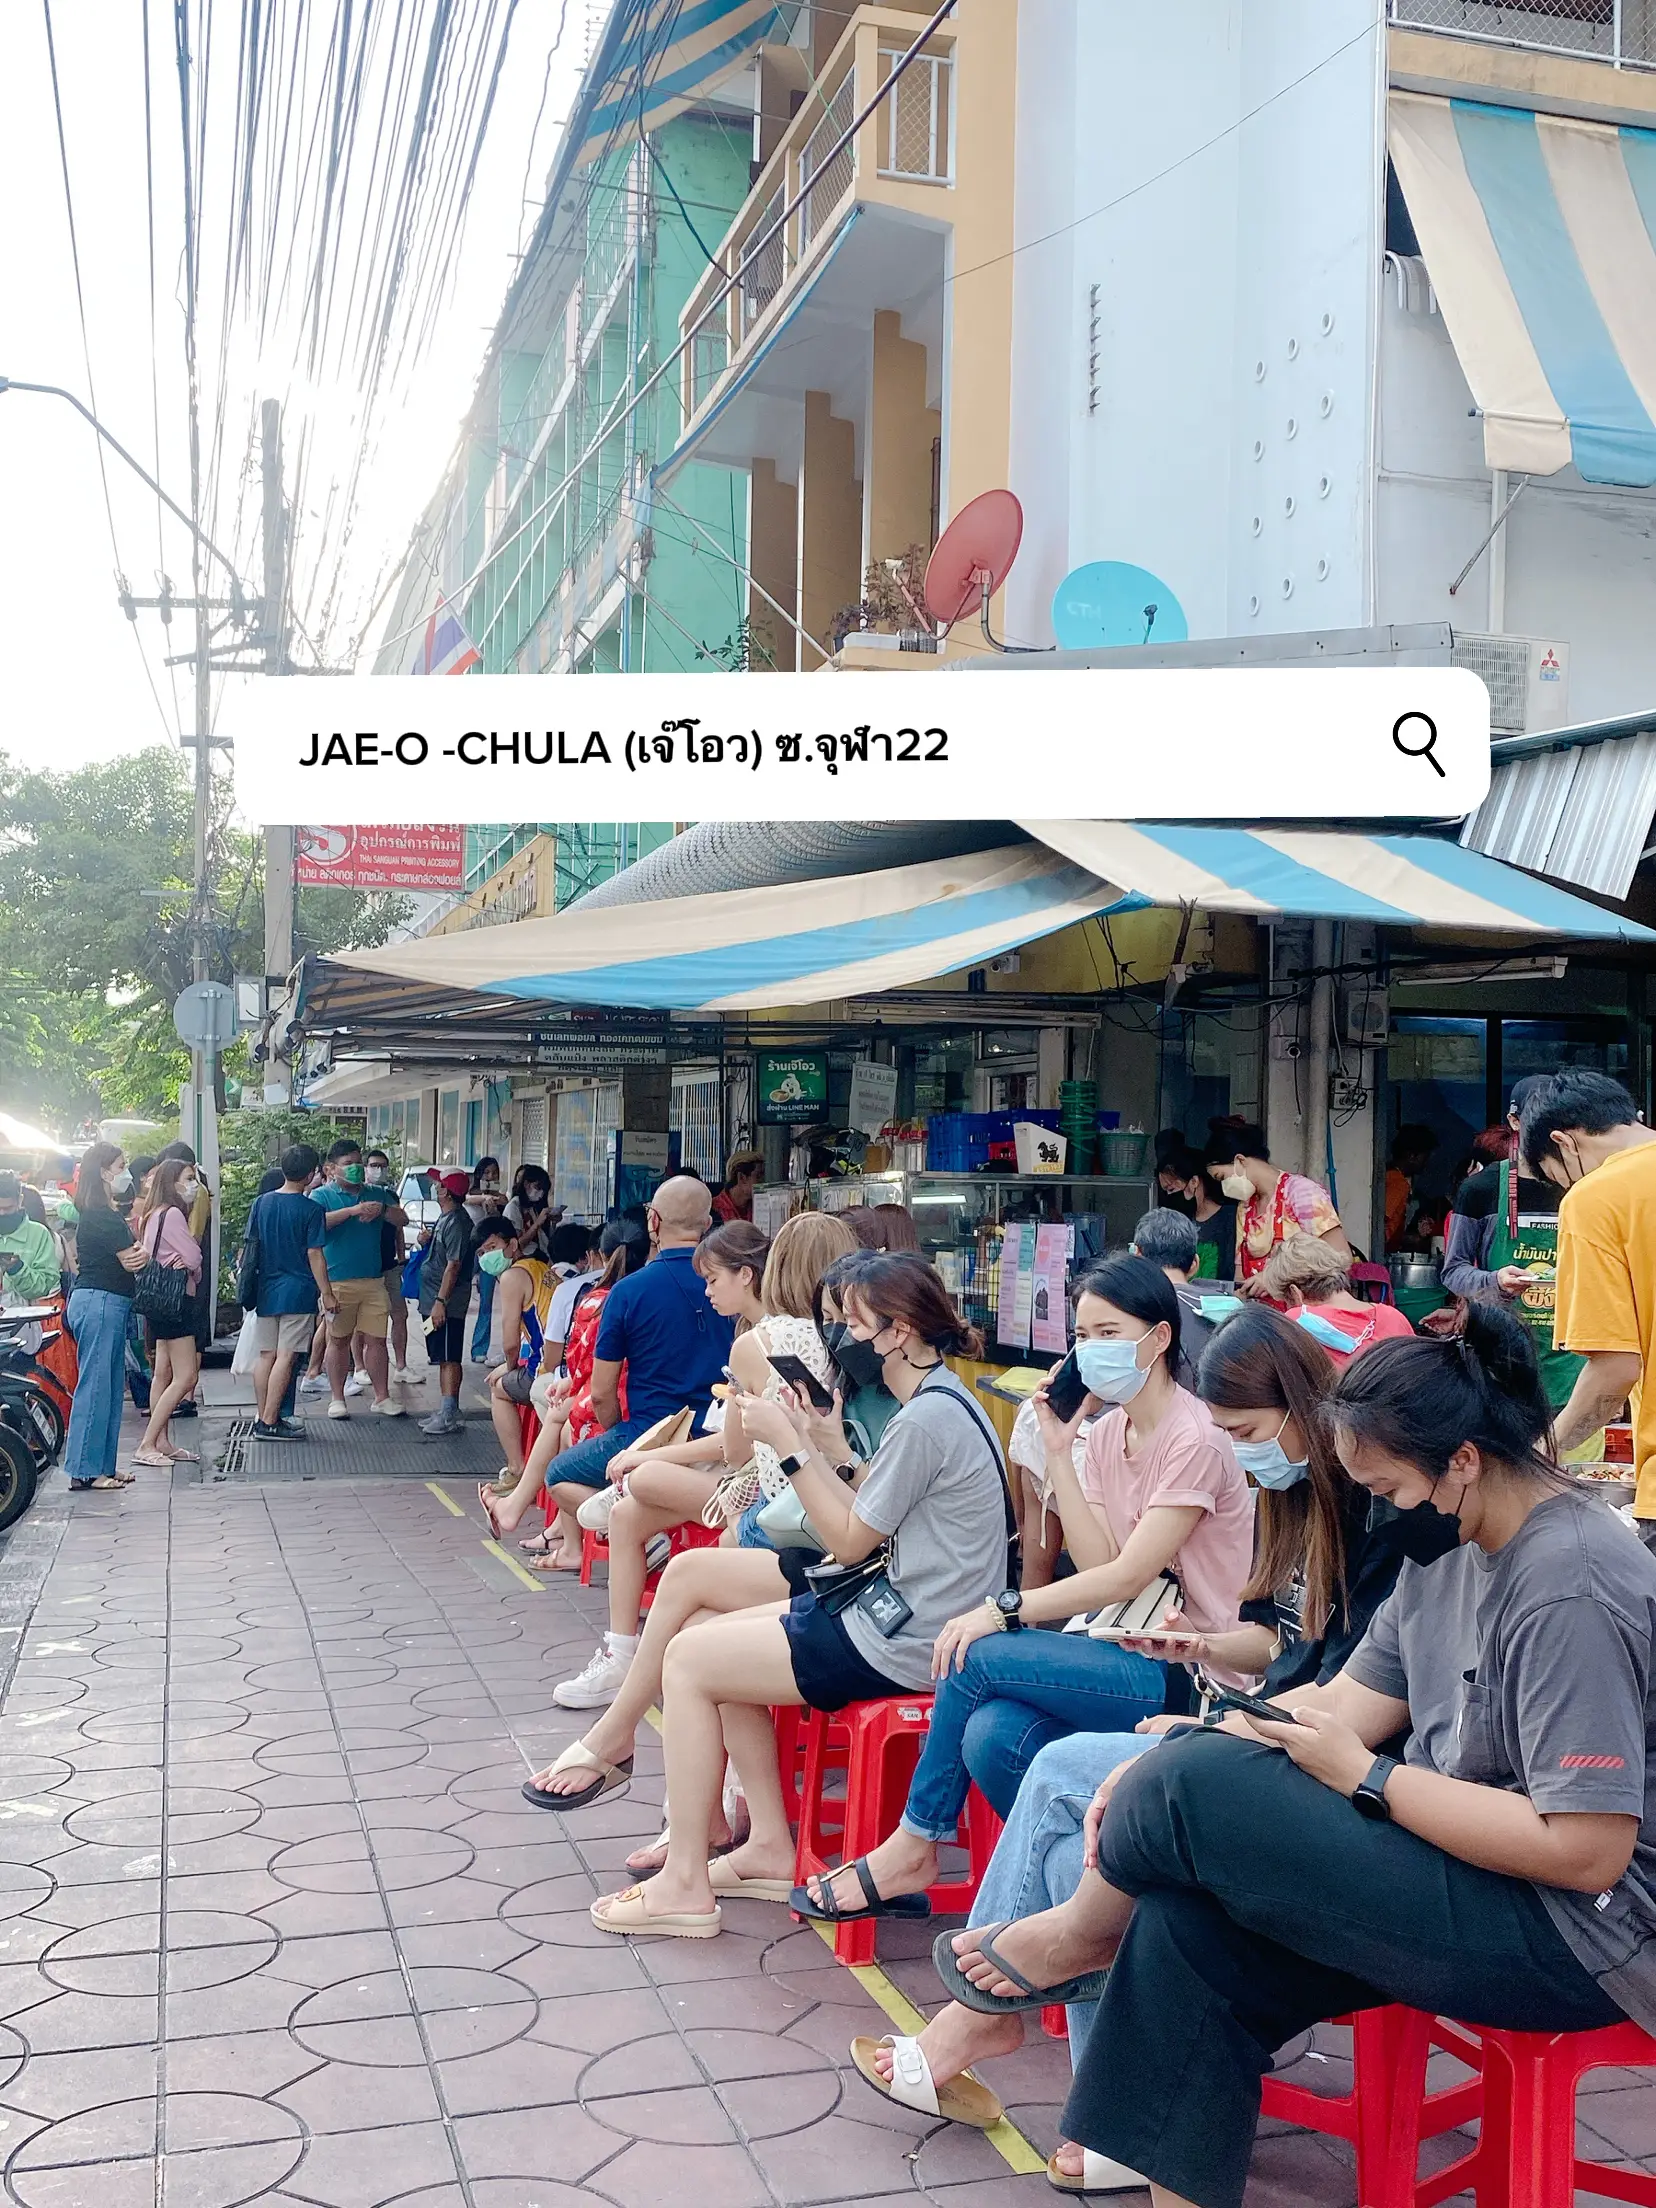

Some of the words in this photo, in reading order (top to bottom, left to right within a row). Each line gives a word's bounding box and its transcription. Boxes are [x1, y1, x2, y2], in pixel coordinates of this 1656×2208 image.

[360, 830, 462, 853] อุปกรณ์การพิมพ์
[401, 856, 427, 868] PRINTING
[427, 857, 460, 869] ACCESSORY
